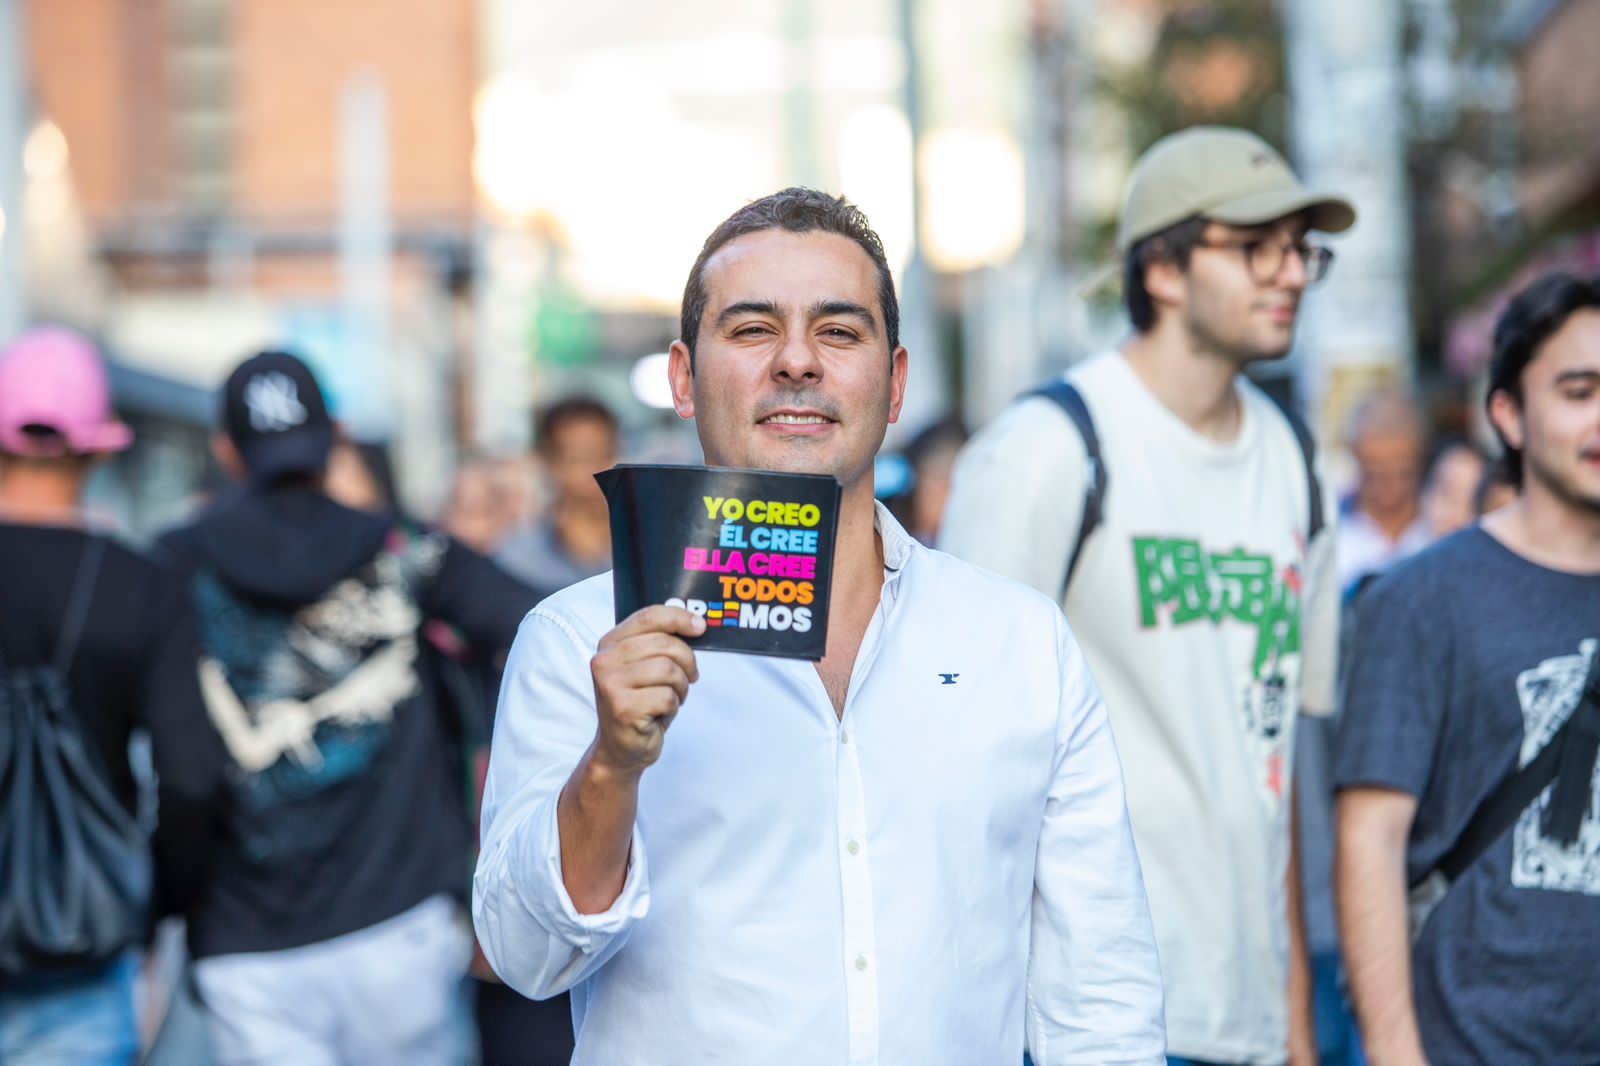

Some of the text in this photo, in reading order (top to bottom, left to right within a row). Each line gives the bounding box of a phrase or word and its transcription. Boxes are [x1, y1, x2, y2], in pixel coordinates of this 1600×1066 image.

[703, 496, 821, 527] YO CREO
[719, 518, 818, 554] ÉL CREE
[683, 546, 817, 579] ELLA CREE
[719, 576, 814, 604] TODOS
